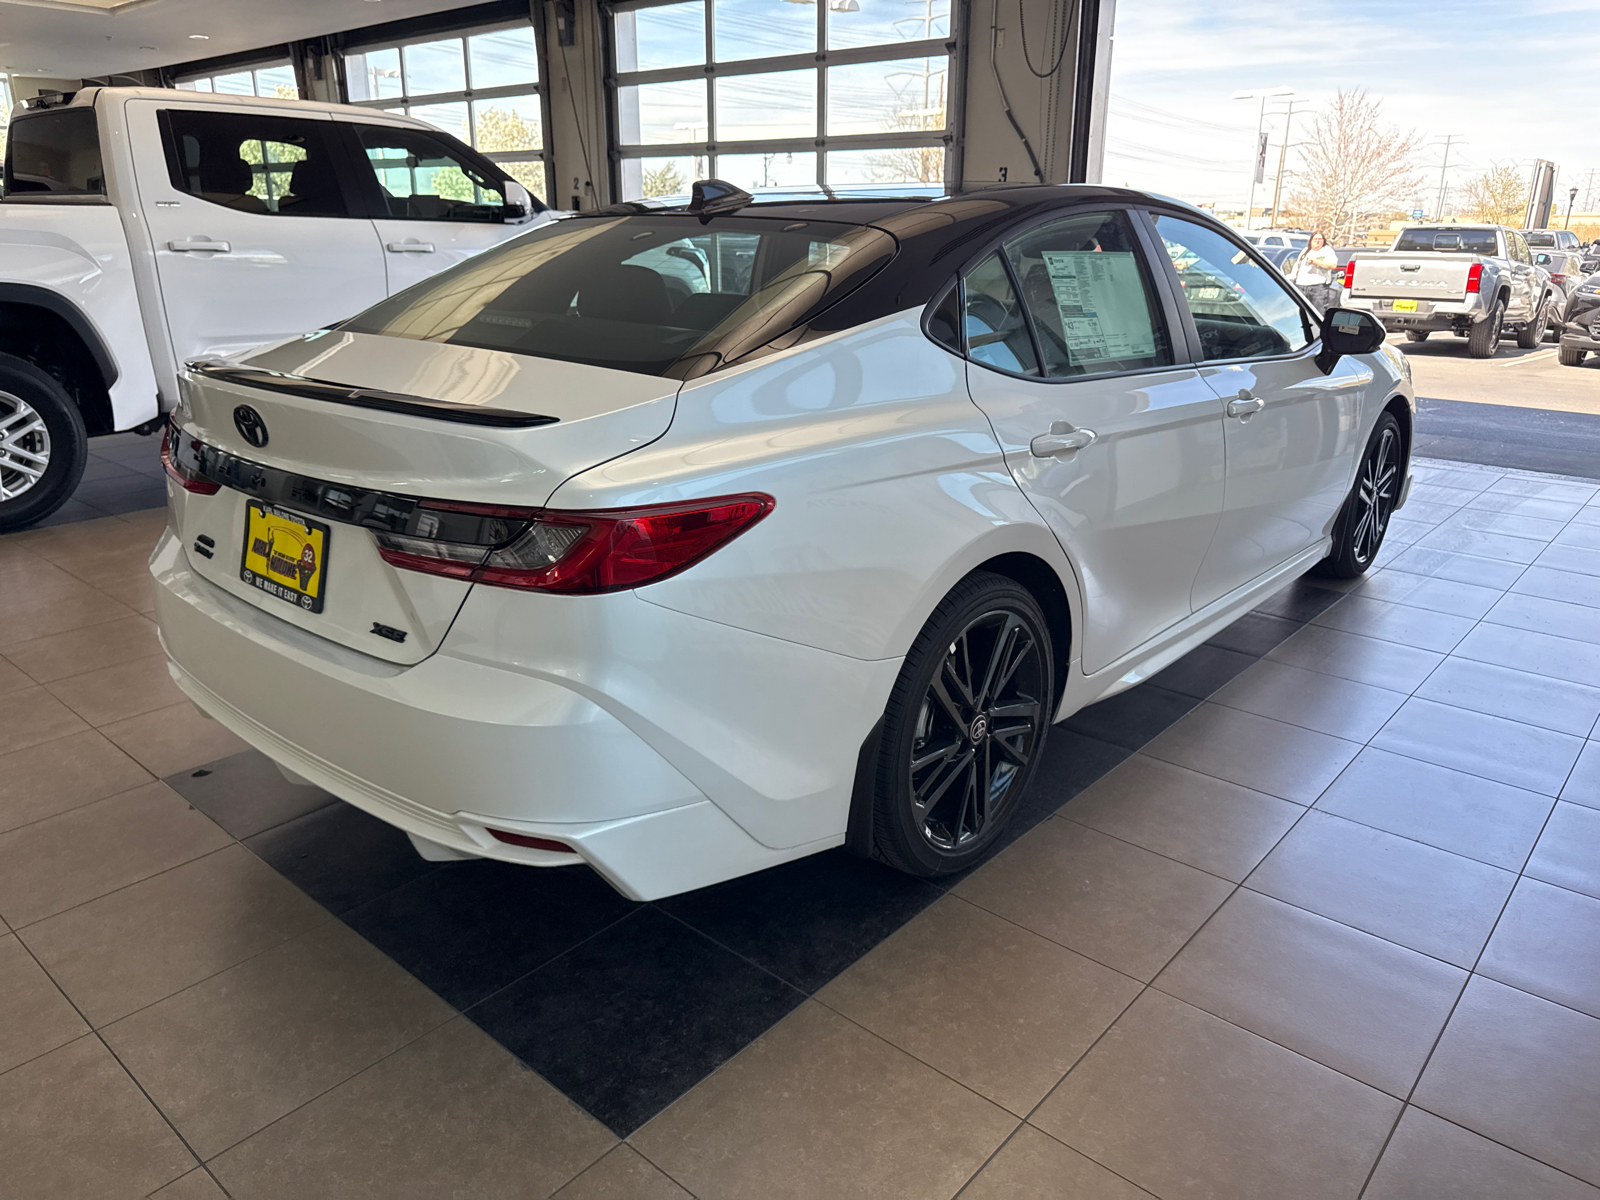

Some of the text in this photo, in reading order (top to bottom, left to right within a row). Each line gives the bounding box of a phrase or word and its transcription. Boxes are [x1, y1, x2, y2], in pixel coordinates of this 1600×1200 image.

[998, 166, 1008, 182] 3
[573, 177, 580, 190] 2
[1369, 278, 1448, 288] TACOMA
[304, 550, 312, 563] 32
[255, 576, 298, 603] WE MAKE IT EASY
[369, 621, 408, 643] XSE
